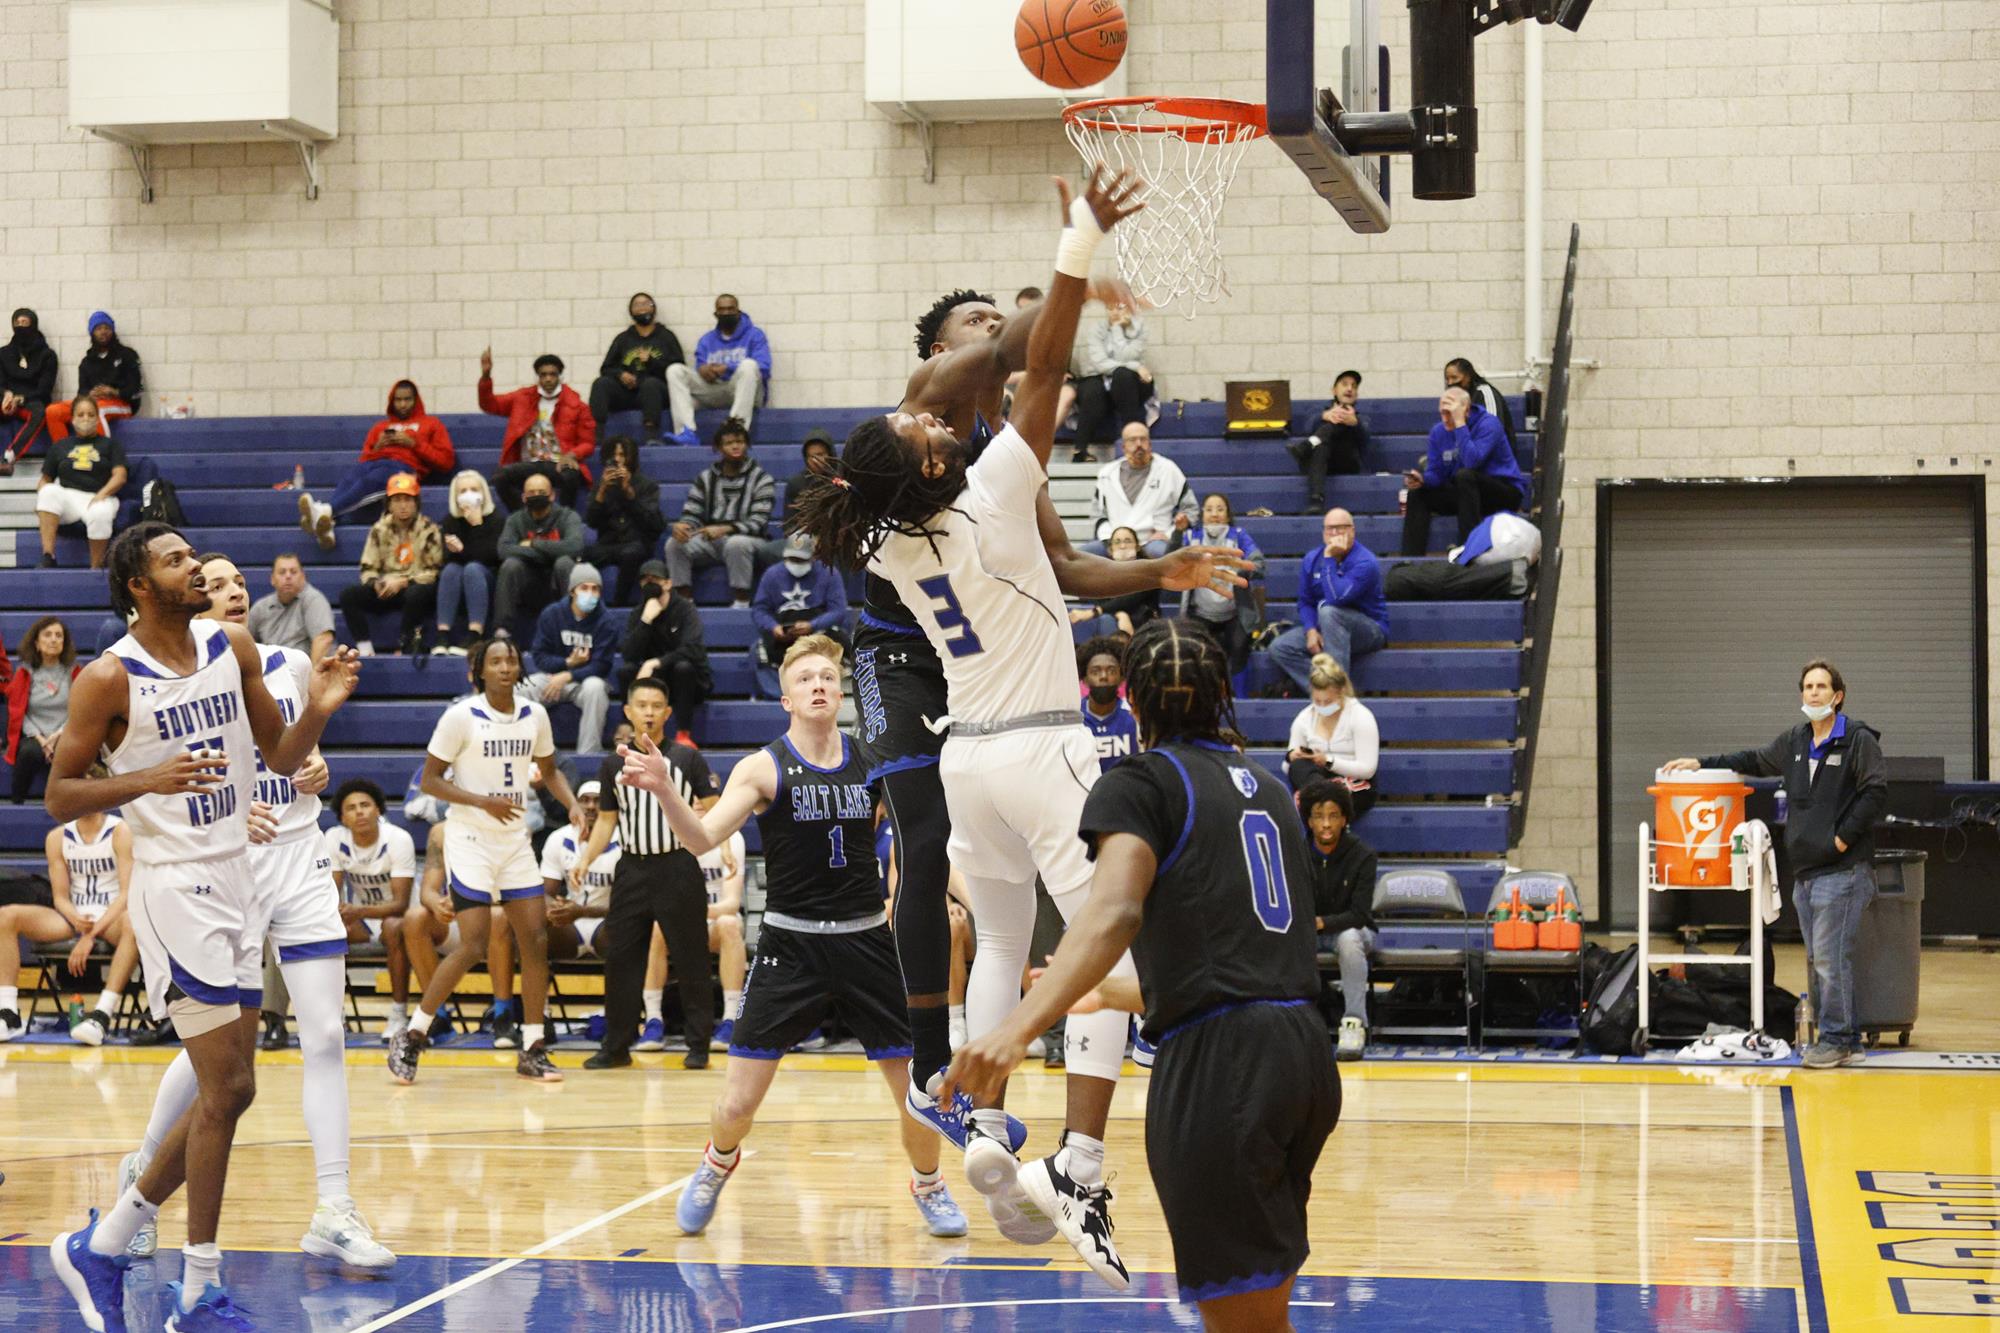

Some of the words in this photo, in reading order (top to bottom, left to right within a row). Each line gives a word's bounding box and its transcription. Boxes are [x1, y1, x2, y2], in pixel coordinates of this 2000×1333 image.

[916, 573, 985, 659] 3
[154, 690, 238, 740] SOUTHERN
[483, 740, 531, 757] SOUTHERN
[1096, 734, 1130, 758] SN
[504, 763, 513, 787] 5
[792, 785, 831, 822] SALT
[832, 784, 872, 819] LAKE
[1689, 801, 1716, 831] G
[828, 825, 847, 868] 1
[1239, 810, 1292, 934] 0
